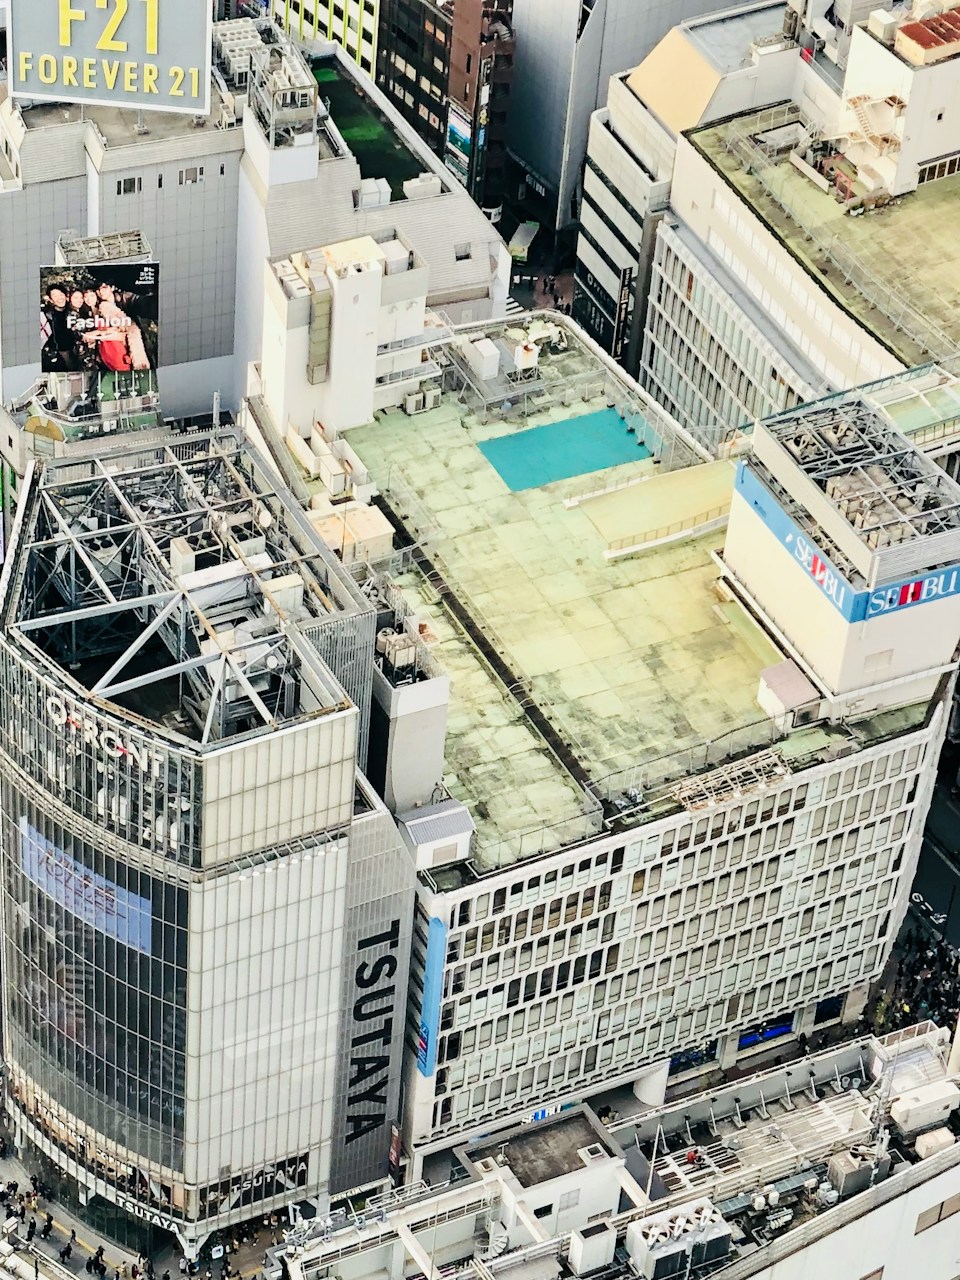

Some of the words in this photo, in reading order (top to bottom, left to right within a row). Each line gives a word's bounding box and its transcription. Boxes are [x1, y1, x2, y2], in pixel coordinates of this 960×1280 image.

[19, 51, 159, 94] FOREVER
[168, 66, 199, 98] 21
[67, 315, 132, 329] Fashion
[795, 536, 845, 609] SEIBU
[869, 571, 957, 615] SEIBU
[46, 696, 165, 777] QFRONT
[345, 918, 400, 1145] TSUTAYA
[232, 1160, 308, 1193] TSUTAYA
[116, 1196, 180, 1234] TSUTAYA
